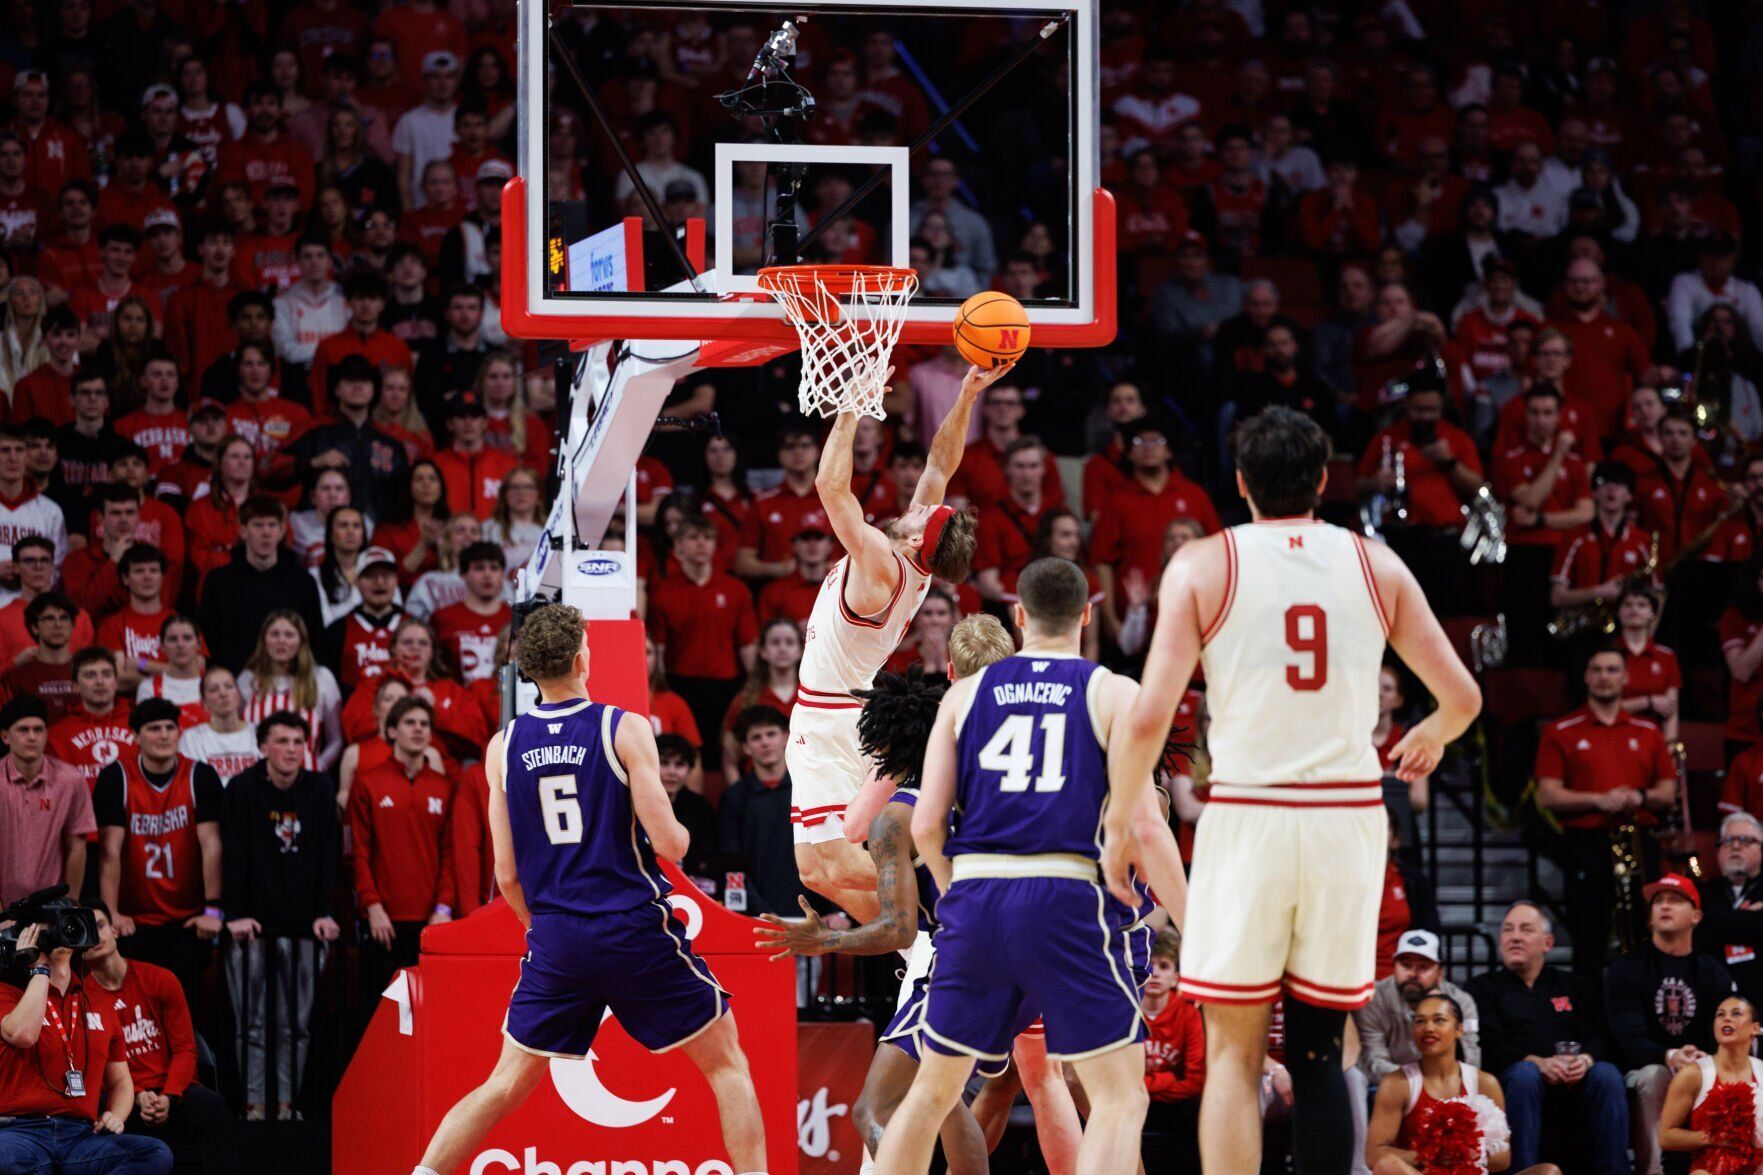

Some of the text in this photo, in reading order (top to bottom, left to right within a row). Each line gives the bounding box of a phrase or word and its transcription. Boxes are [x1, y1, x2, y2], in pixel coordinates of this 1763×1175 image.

[998, 329, 1019, 349] N
[1289, 536, 1304, 549] N
[1285, 604, 1328, 691] 9
[1031, 661, 1051, 672] W
[547, 723, 563, 734] W
[521, 745, 587, 771] STEINBACH
[978, 713, 1067, 793] 41
[538, 774, 584, 845] 6
[144, 842, 174, 879] 21
[661, 1116, 674, 1124] TM
